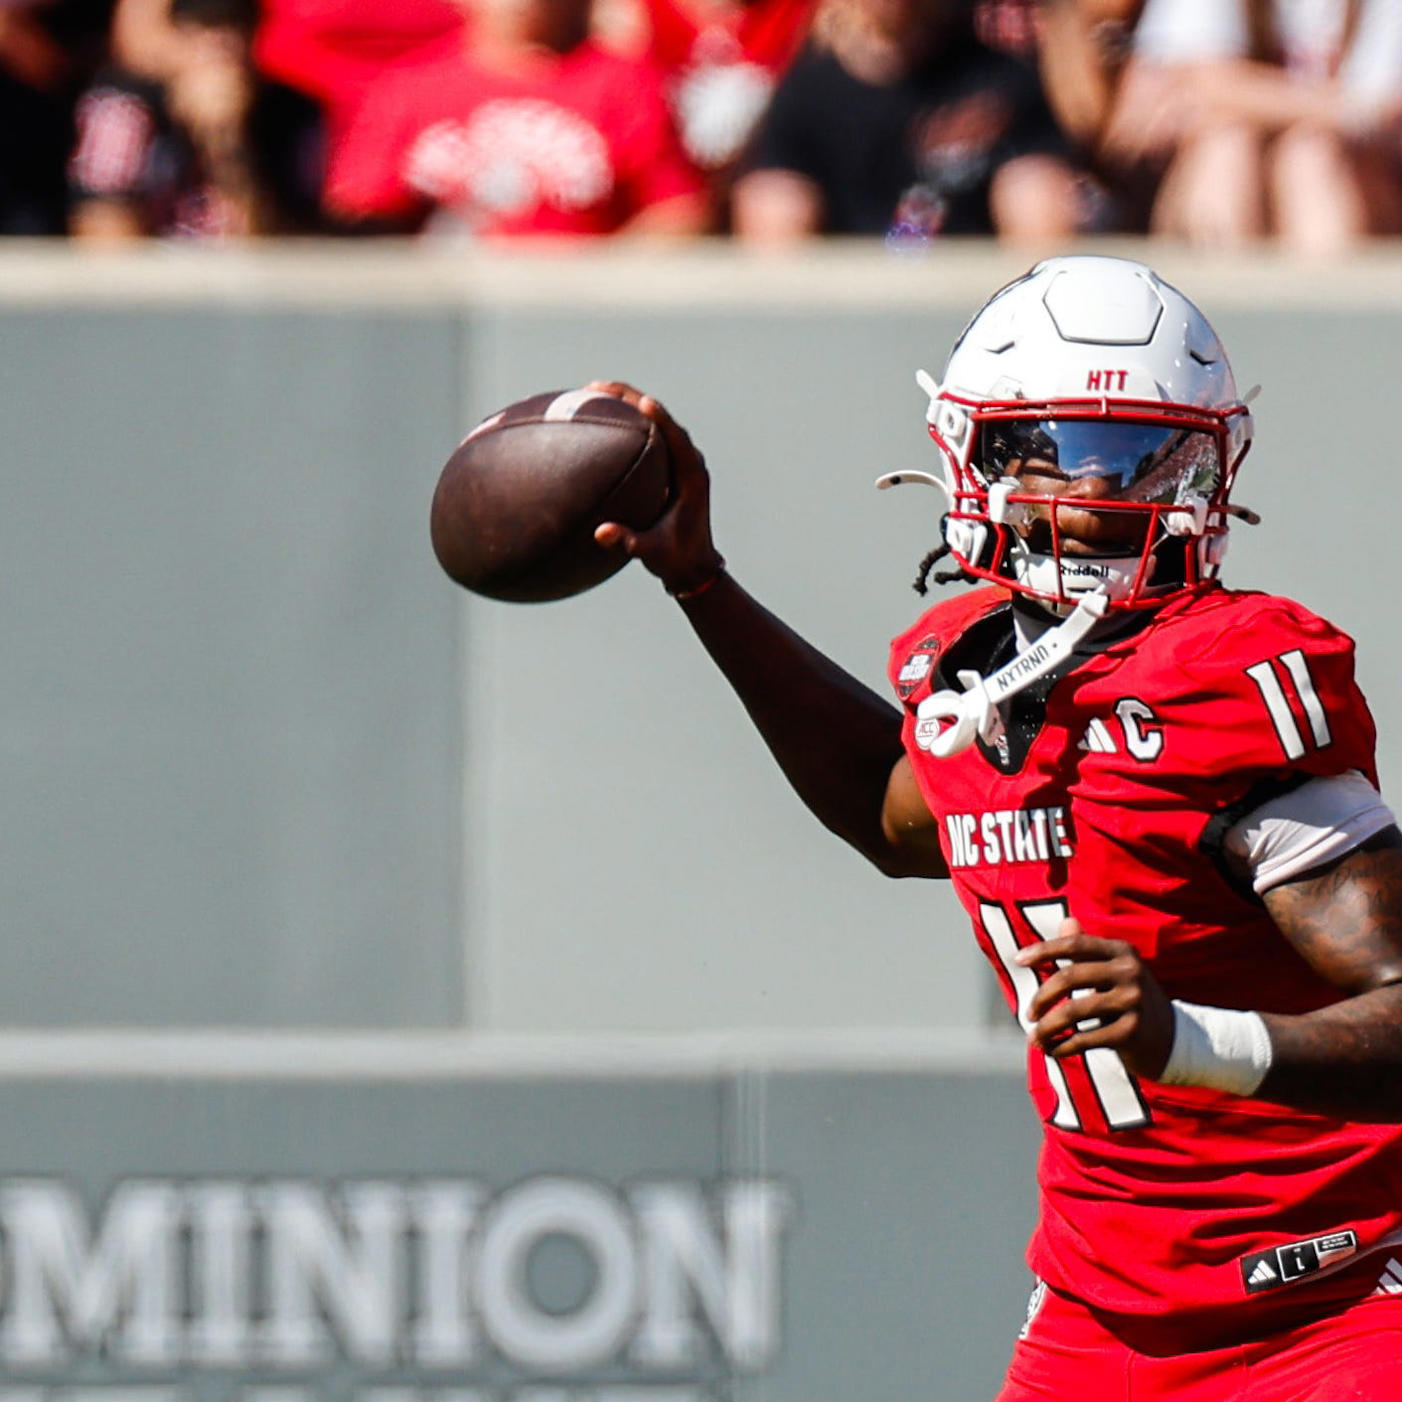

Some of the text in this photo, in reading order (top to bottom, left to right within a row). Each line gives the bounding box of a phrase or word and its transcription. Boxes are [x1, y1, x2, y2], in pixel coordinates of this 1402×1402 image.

[1086, 369, 1130, 392] HTT
[1115, 697, 1165, 762] C
[1245, 649, 1333, 760] 11
[946, 805, 1073, 867] NC STATE
[980, 898, 1152, 1131] 11
